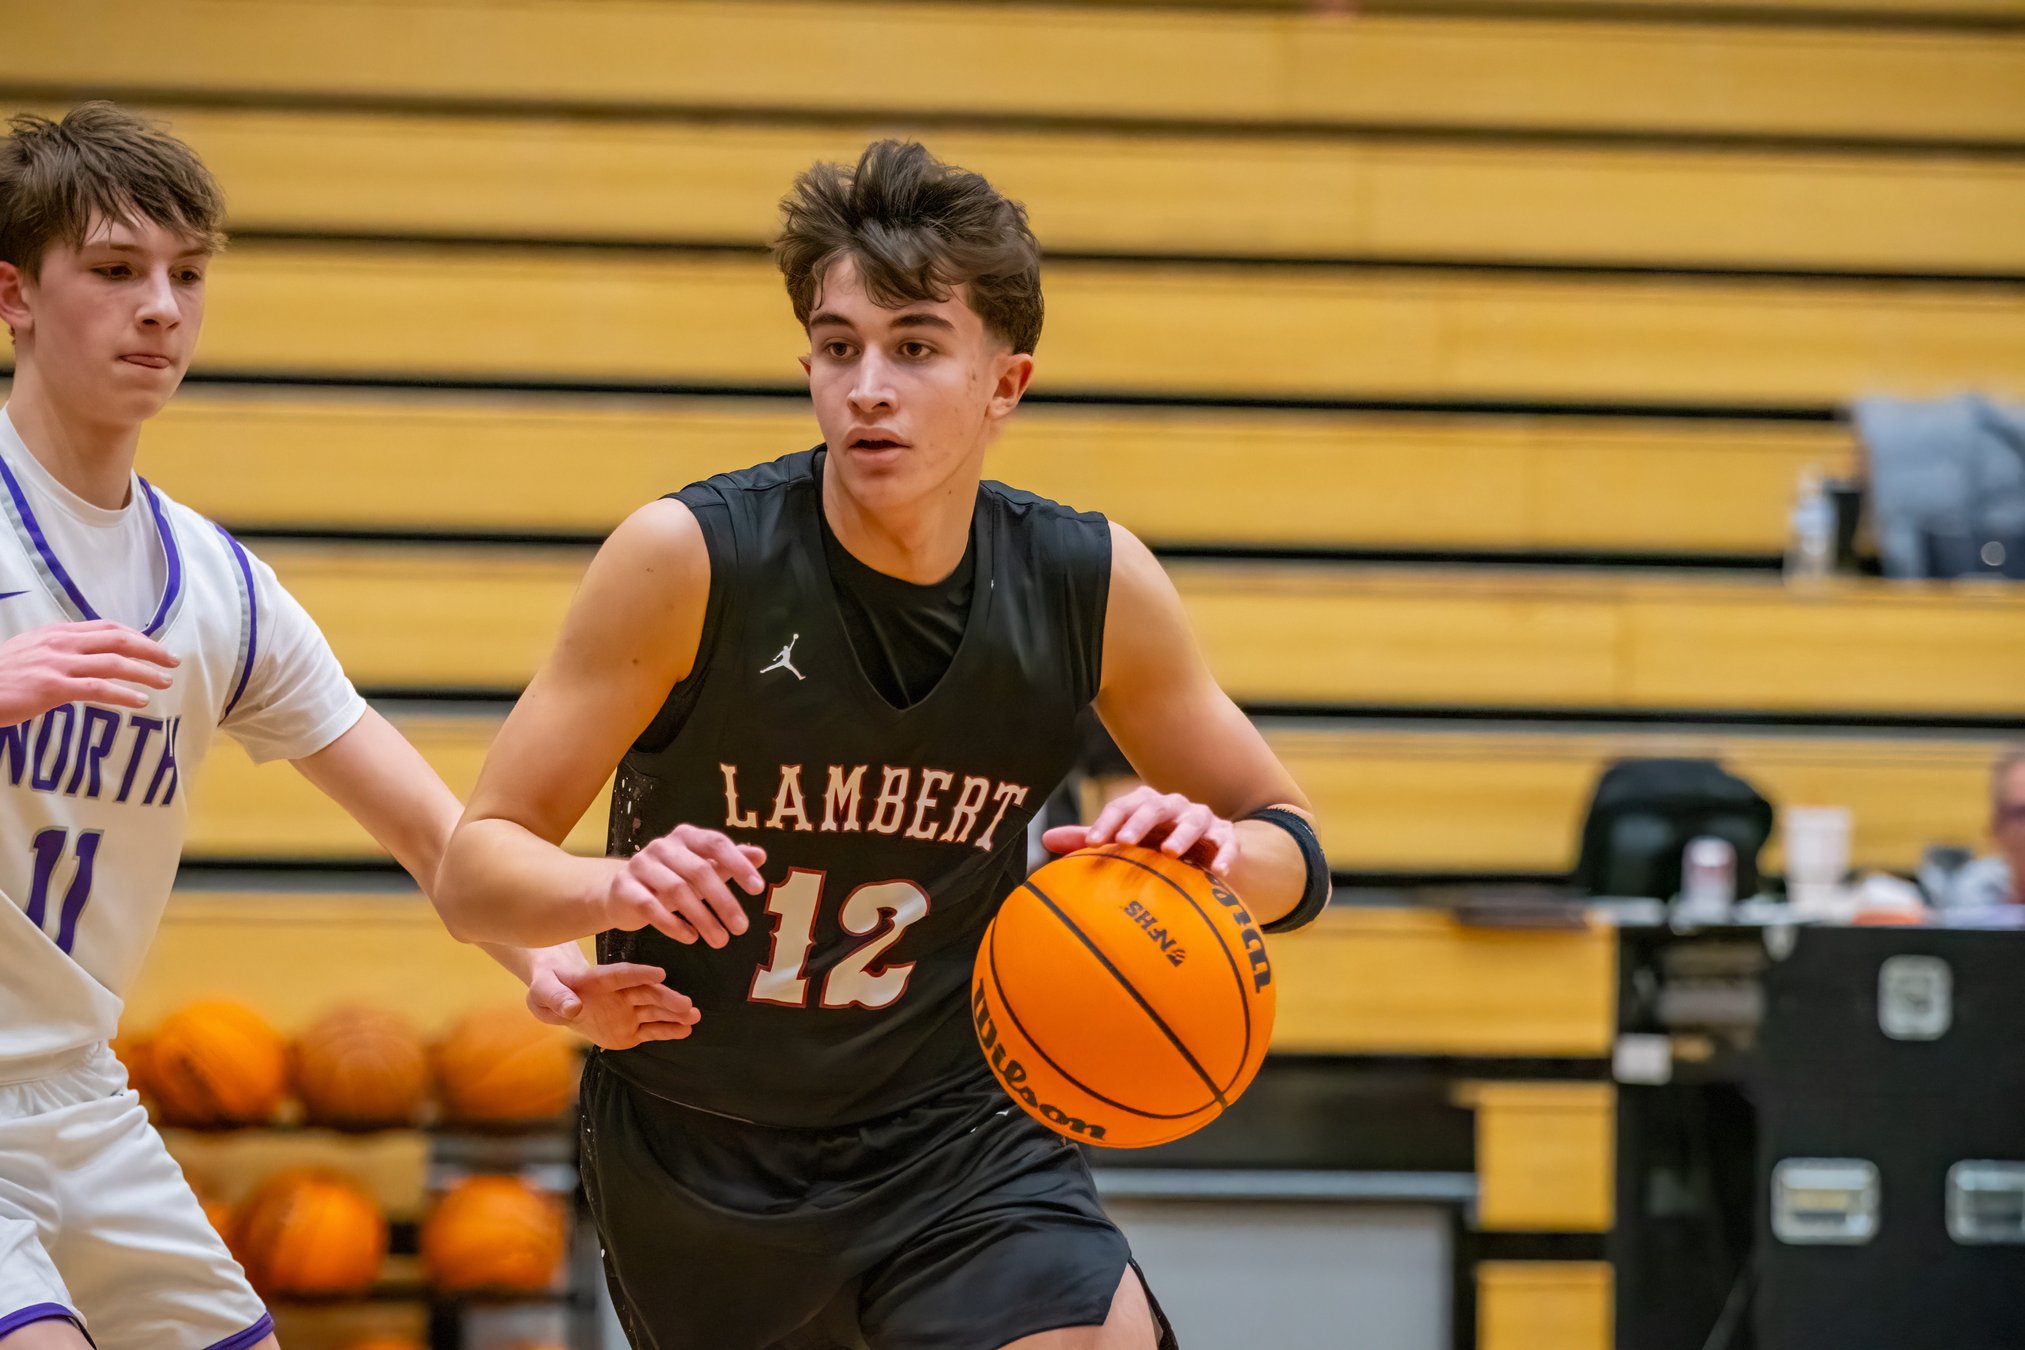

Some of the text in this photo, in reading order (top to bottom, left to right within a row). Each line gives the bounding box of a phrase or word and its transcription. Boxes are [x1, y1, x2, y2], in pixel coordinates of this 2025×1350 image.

[0, 702, 181, 807] NORTH
[718, 760, 1030, 853] LAMBERT
[26, 826, 104, 956] 11
[747, 866, 931, 1011] 12
[1123, 900, 1178, 953] NFHS
[973, 977, 1107, 1141] Wilson
